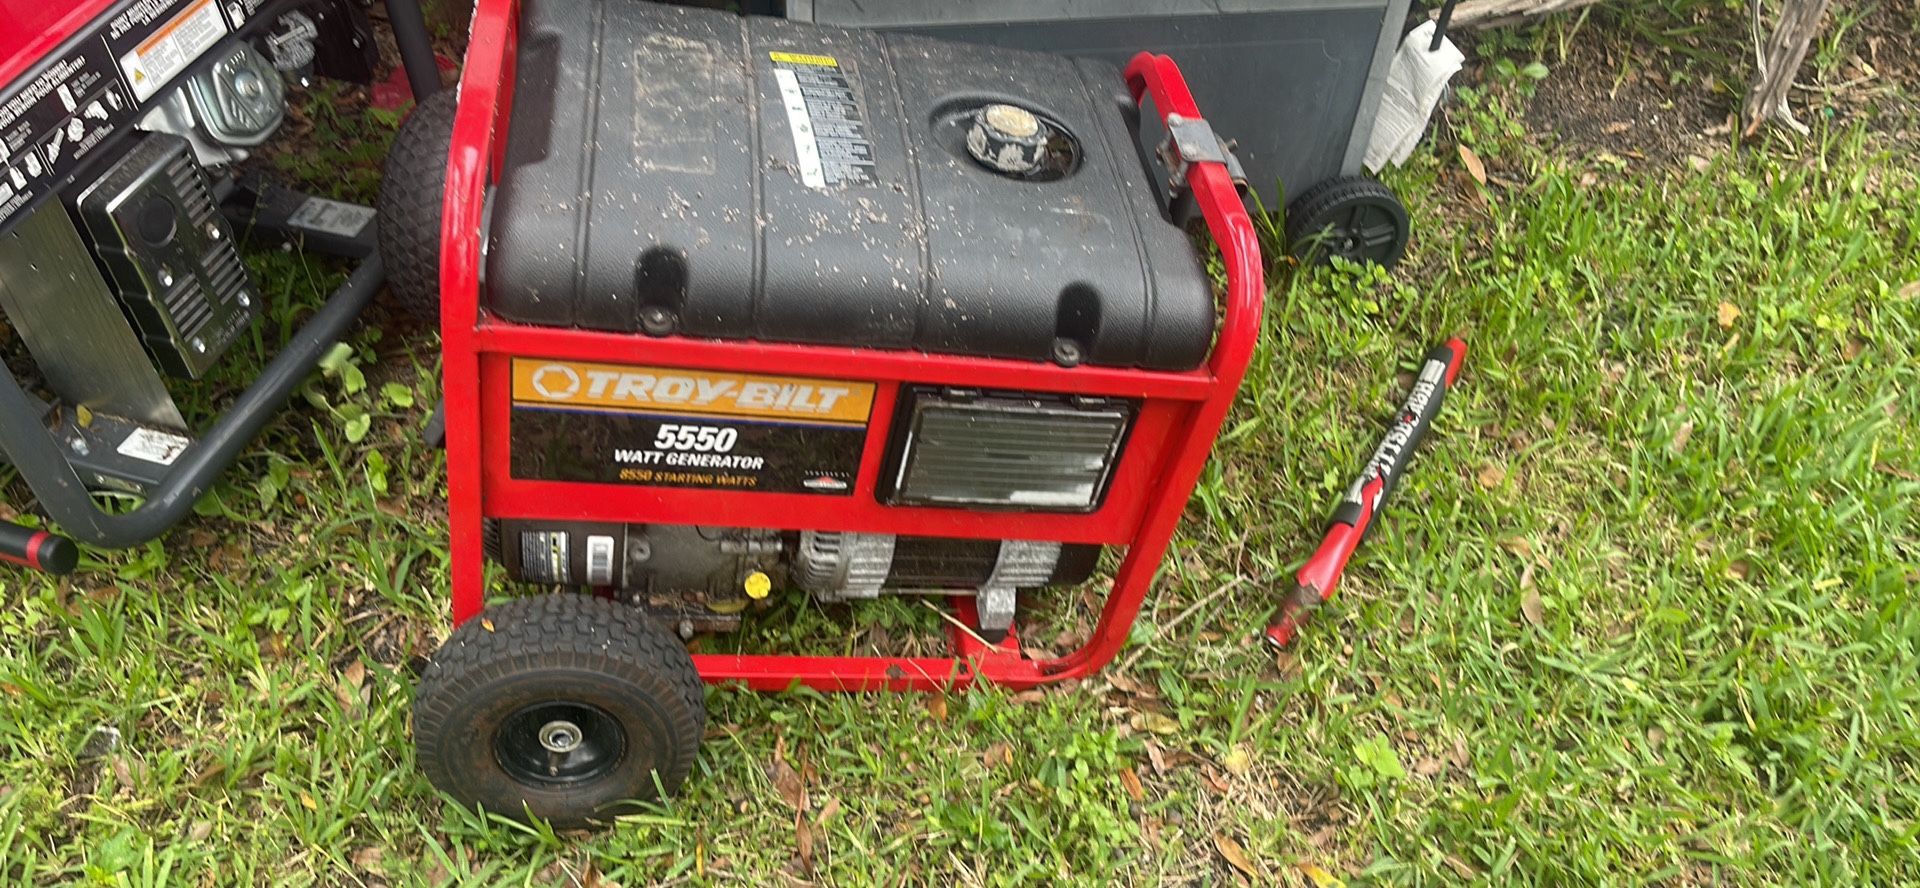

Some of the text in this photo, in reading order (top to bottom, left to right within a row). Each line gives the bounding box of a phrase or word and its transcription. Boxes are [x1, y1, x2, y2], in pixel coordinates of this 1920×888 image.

[586, 371, 850, 414] TROY-BILT
[654, 423, 738, 453] 5550
[614, 449, 765, 470] WATT GENERATOR
[619, 468, 758, 486] 8550 STARTING WATTS
